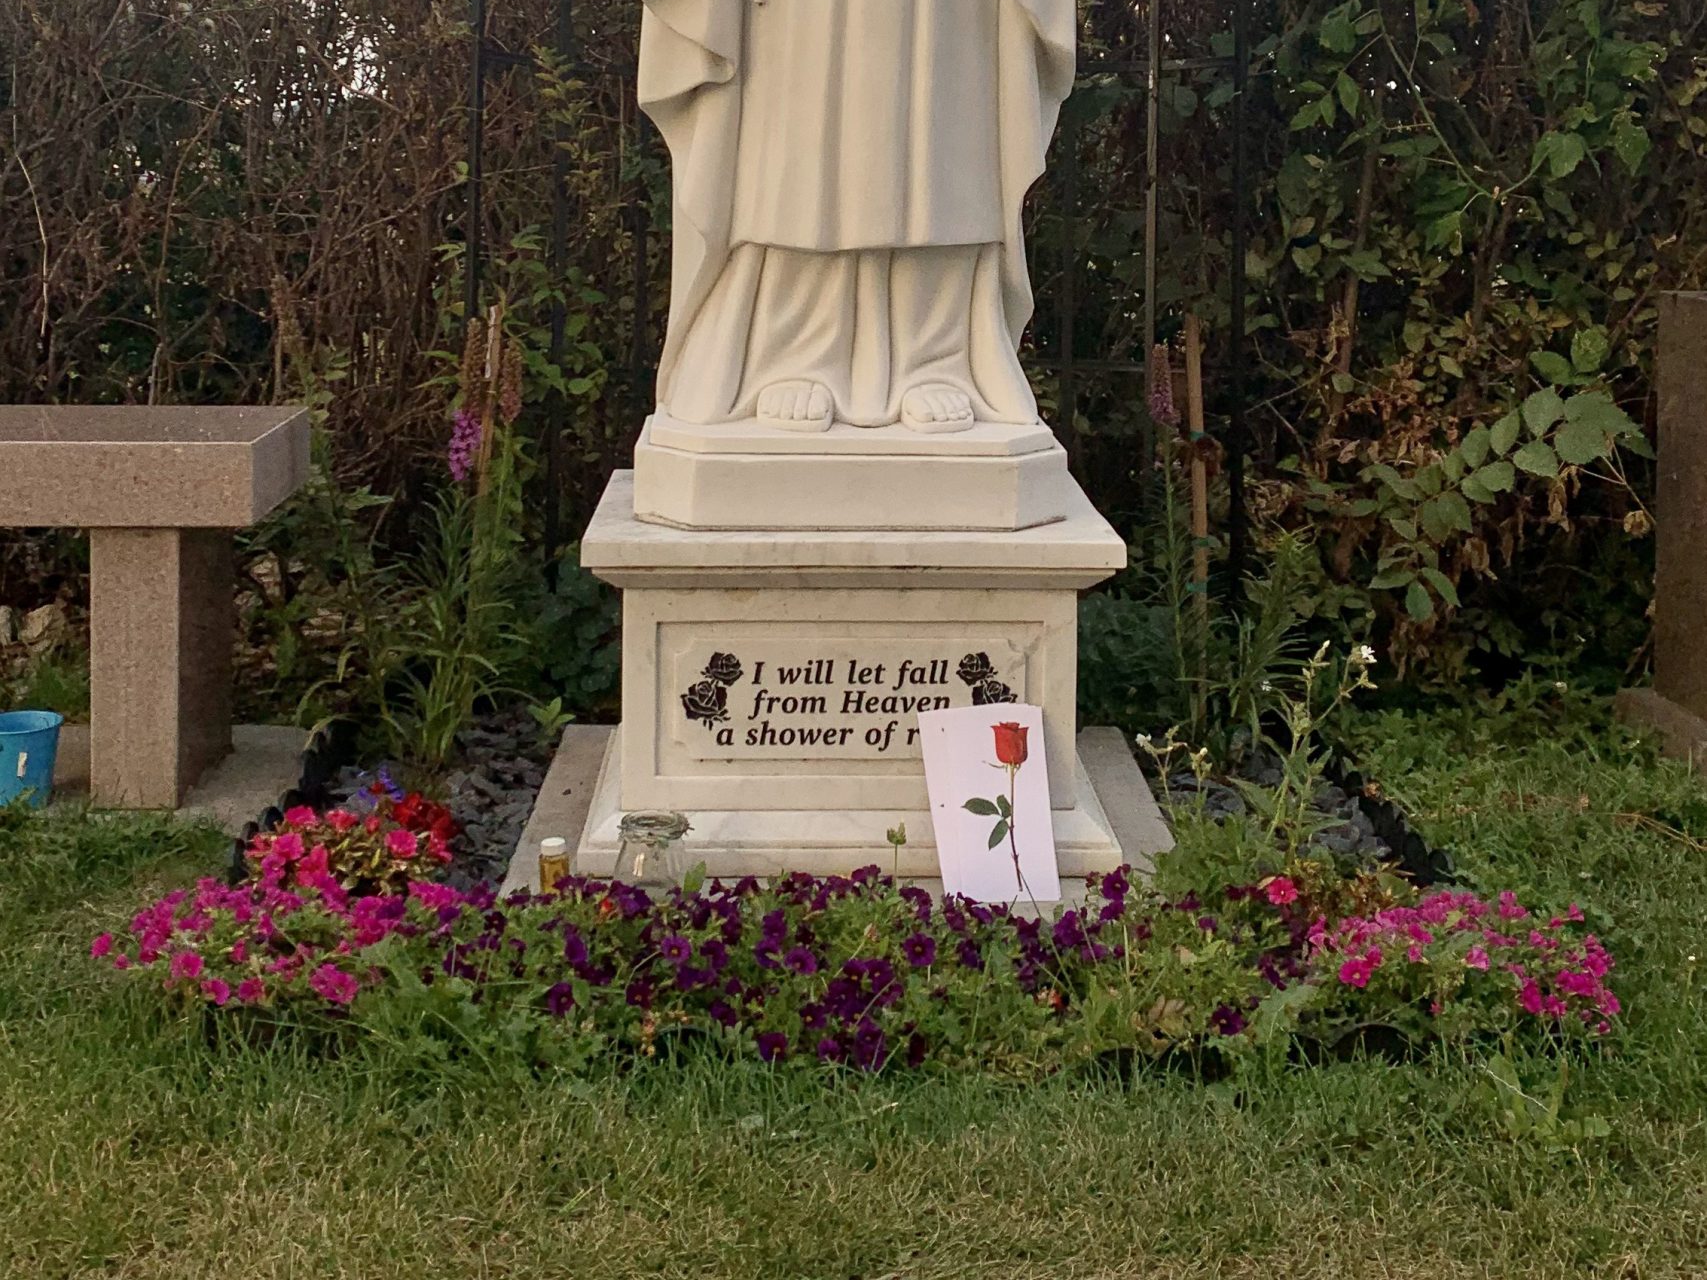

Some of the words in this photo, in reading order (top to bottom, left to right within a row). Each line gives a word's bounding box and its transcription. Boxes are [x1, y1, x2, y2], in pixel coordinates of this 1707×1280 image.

[751, 661, 766, 685] I
[777, 659, 835, 685] will
[847, 659, 887, 685] let
[891, 659, 950, 691] fall
[747, 689, 828, 721] from
[839, 690, 952, 714] Heaven
[715, 728, 735, 746] a
[744, 719, 854, 746] shower
[864, 720, 899, 752] of
